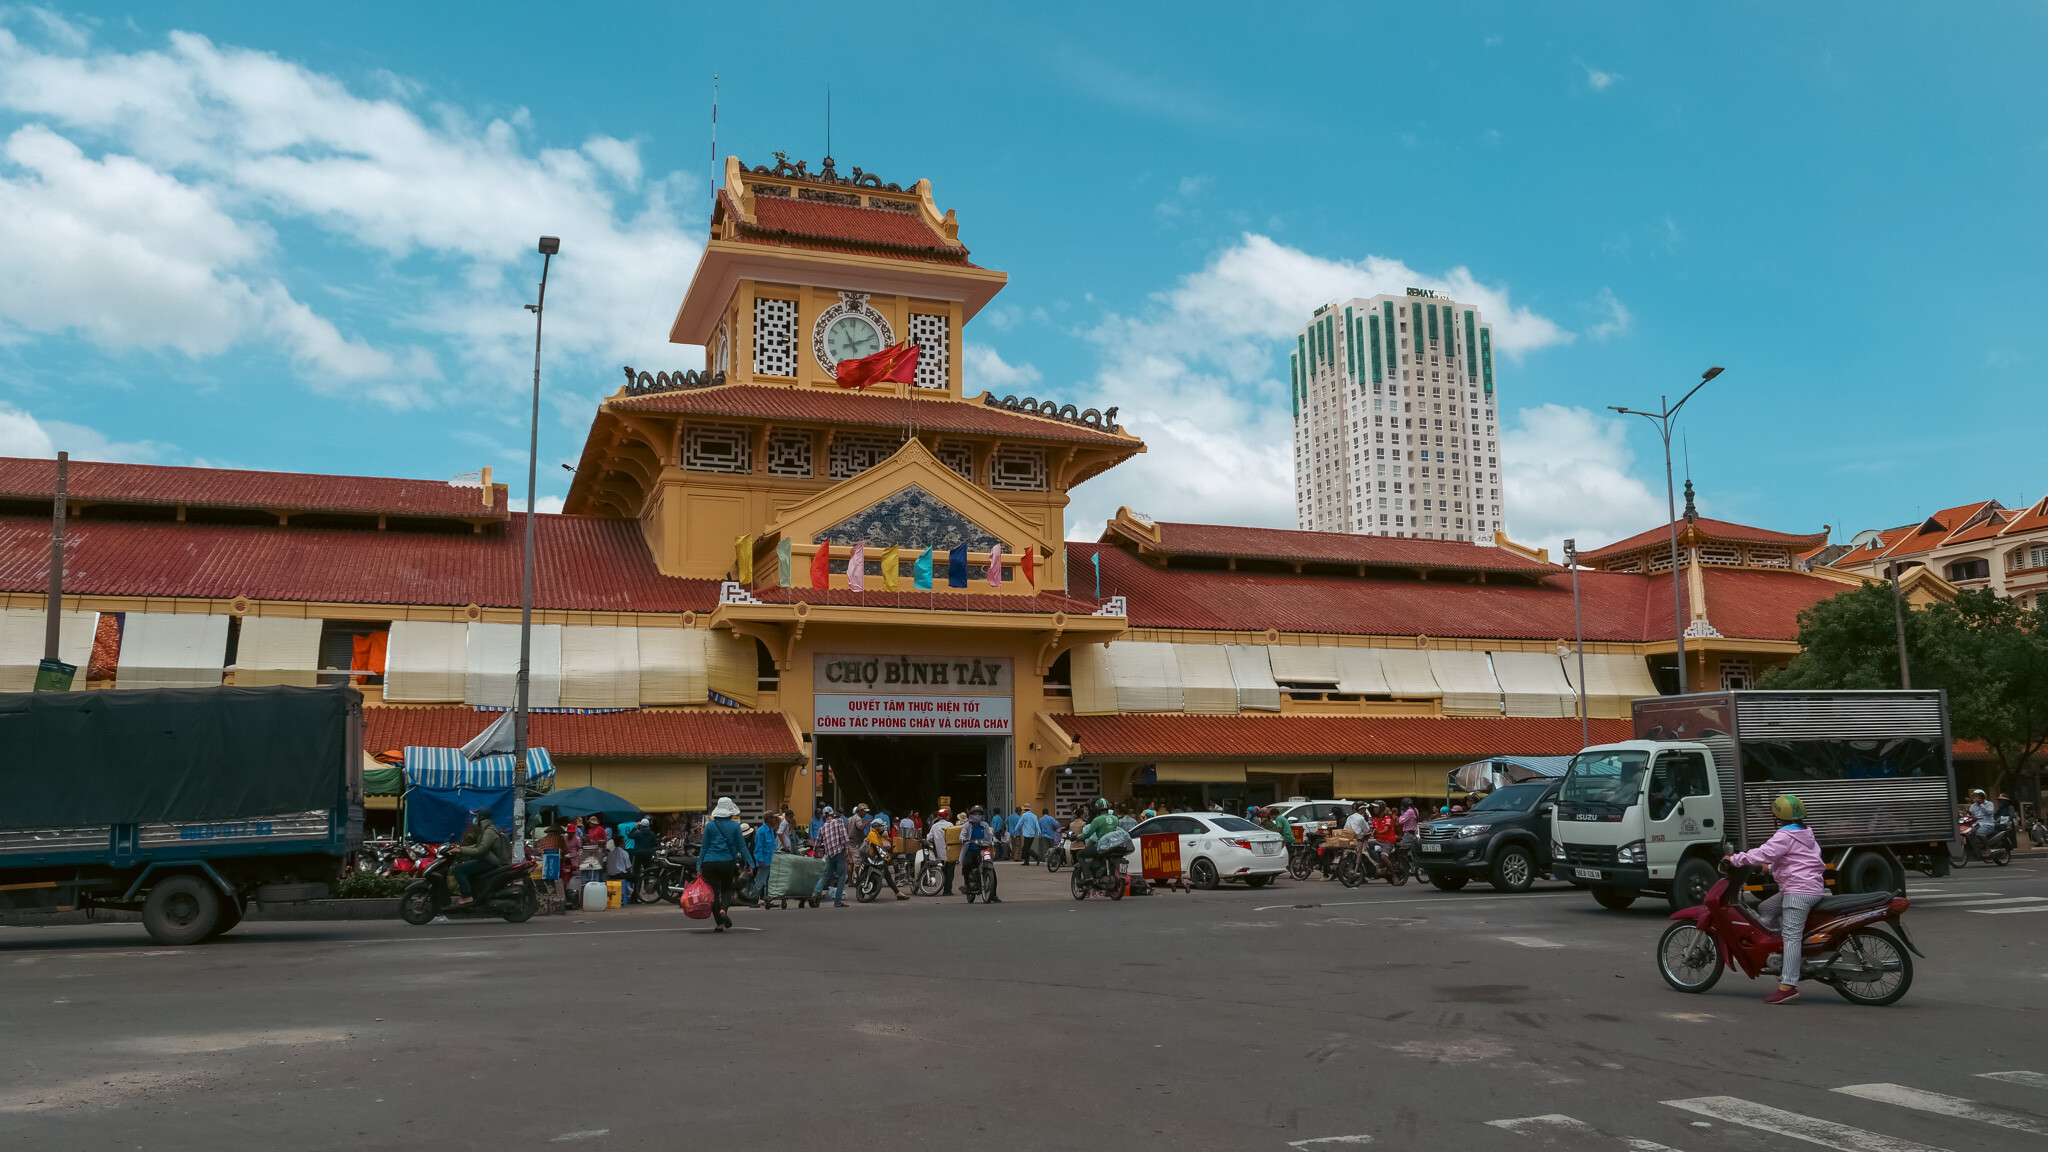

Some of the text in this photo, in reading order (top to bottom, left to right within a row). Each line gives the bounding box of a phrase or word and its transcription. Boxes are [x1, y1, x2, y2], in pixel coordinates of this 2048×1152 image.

[1406, 287, 1434, 298] REMAX
[826, 655, 1002, 689] CHỢ BÌNH TÂY
[848, 698, 980, 714] QUYẾT TÂM THỰC HIỆN TỐT
[817, 715, 1009, 729] CÔNG TÁC PHÒNG CHÁY VÀ CHỮA CHÁY
[1018, 760, 1033, 769] 57A
[1576, 813, 1597, 821] ISUZU
